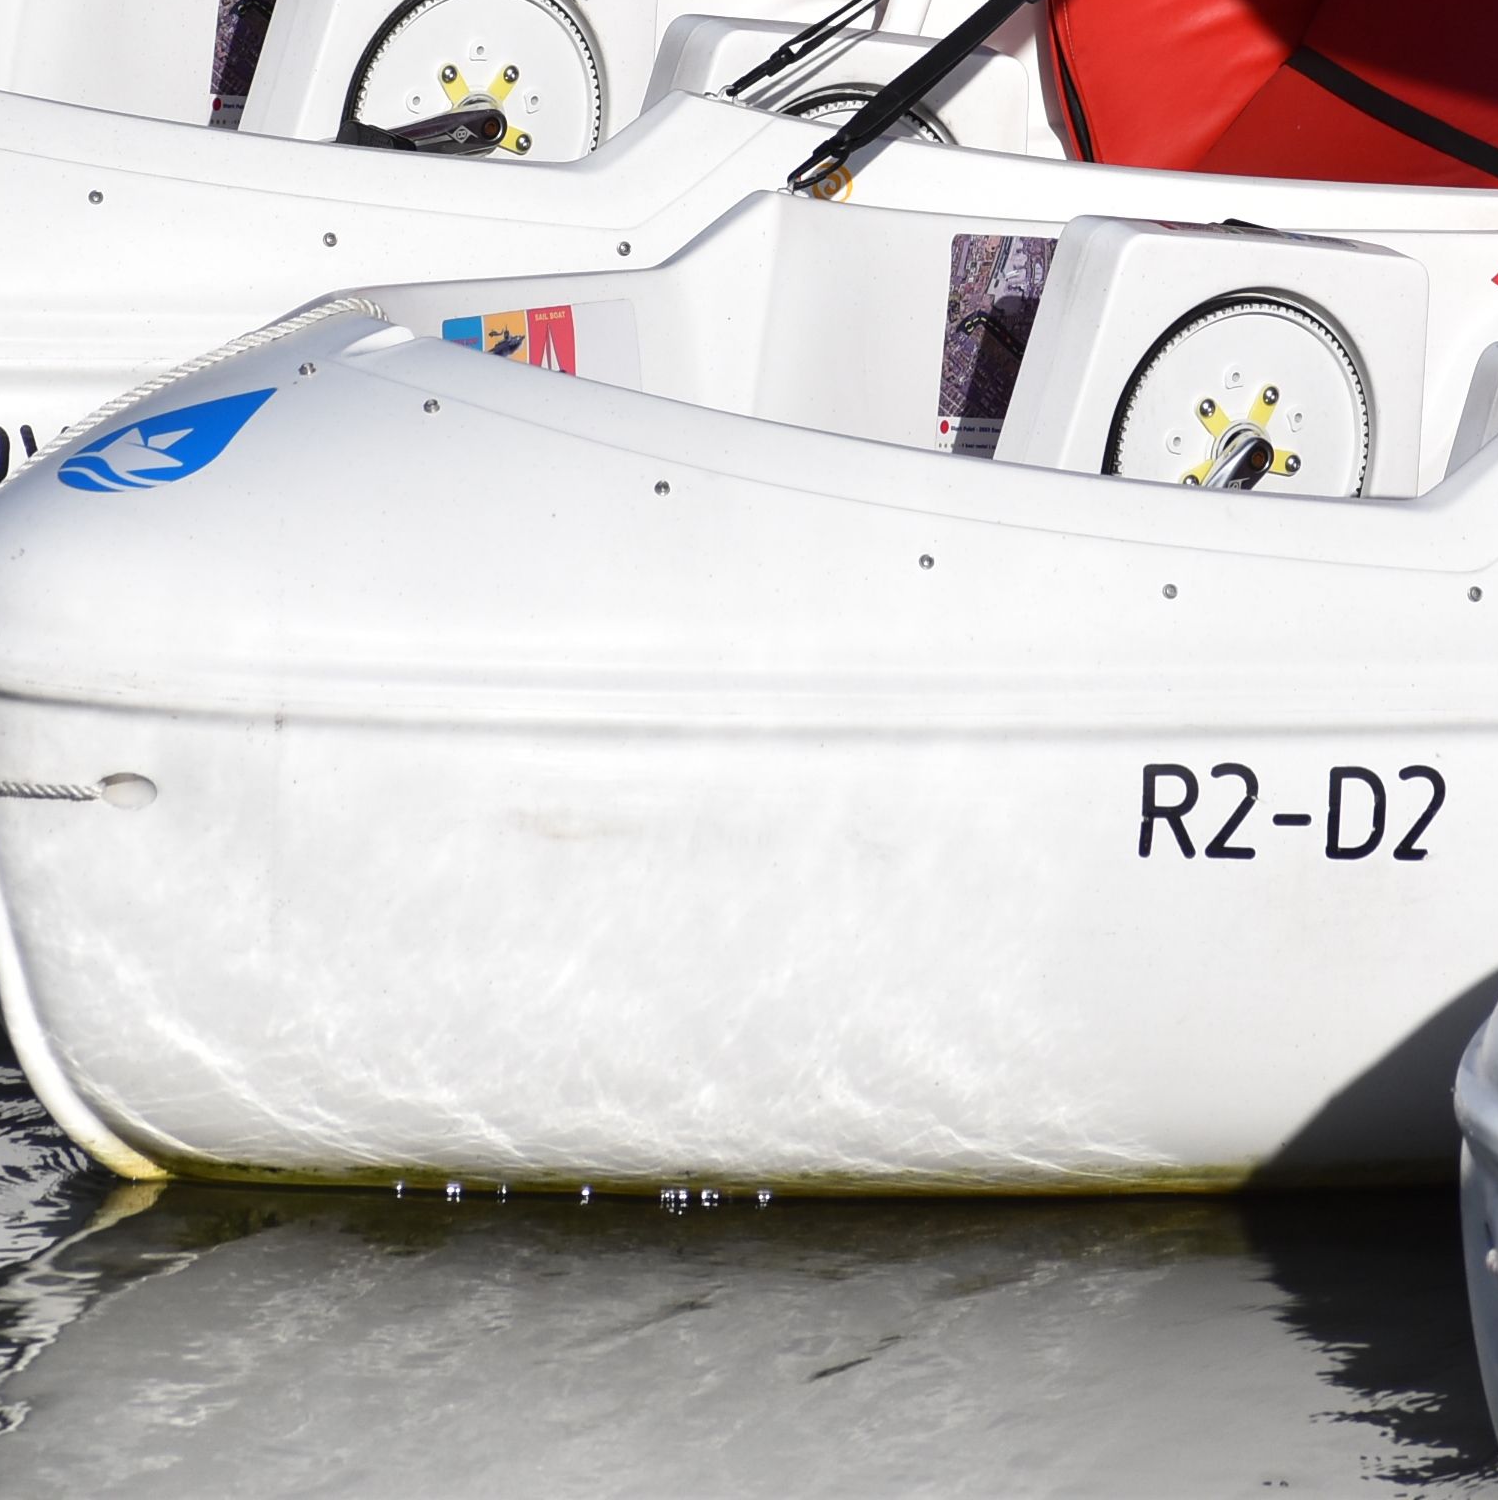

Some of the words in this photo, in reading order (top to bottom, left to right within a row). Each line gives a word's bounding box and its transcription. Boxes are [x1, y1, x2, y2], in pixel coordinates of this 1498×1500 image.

[534, 313, 549, 322] SAIL
[549, 311, 566, 320] BOAT
[1138, 762, 1446, 861] R2-D2
